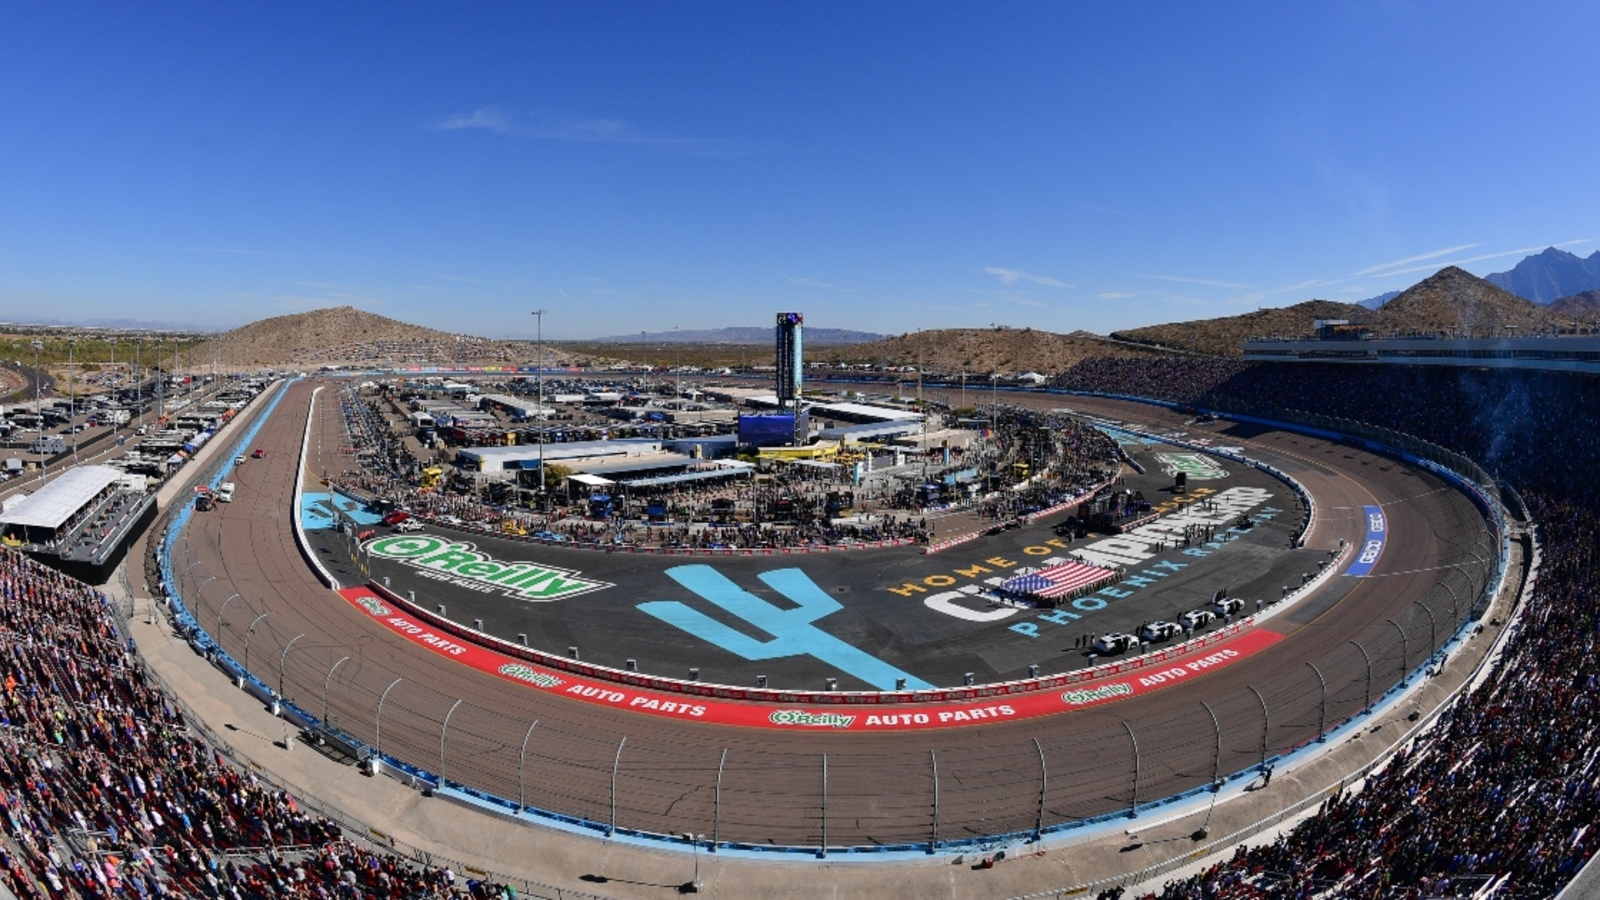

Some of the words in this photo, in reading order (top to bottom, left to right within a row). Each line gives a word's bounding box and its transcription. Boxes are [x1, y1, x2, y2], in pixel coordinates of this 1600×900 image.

[363, 534, 606, 600] O'Reilly
[888, 555, 1018, 597] HOME
[1023, 537, 1068, 556] OF
[1151, 487, 1217, 514] ASCAR
[924, 486, 1275, 622] CMPIONSHIP
[1007, 559, 1189, 638] PHOENIX
[387, 617, 422, 635] AUTO
[417, 632, 467, 656] PARTS
[566, 684, 625, 703] AUTO
[629, 696, 706, 717] PARTS
[1061, 681, 1134, 706] O'Reilly
[1139, 667, 1188, 687] AUTO
[1185, 649, 1239, 671] PARTS
[769, 709, 857, 728] O'Reilly
[865, 713, 930, 727] AUTO
[938, 704, 1016, 723] PARTS
